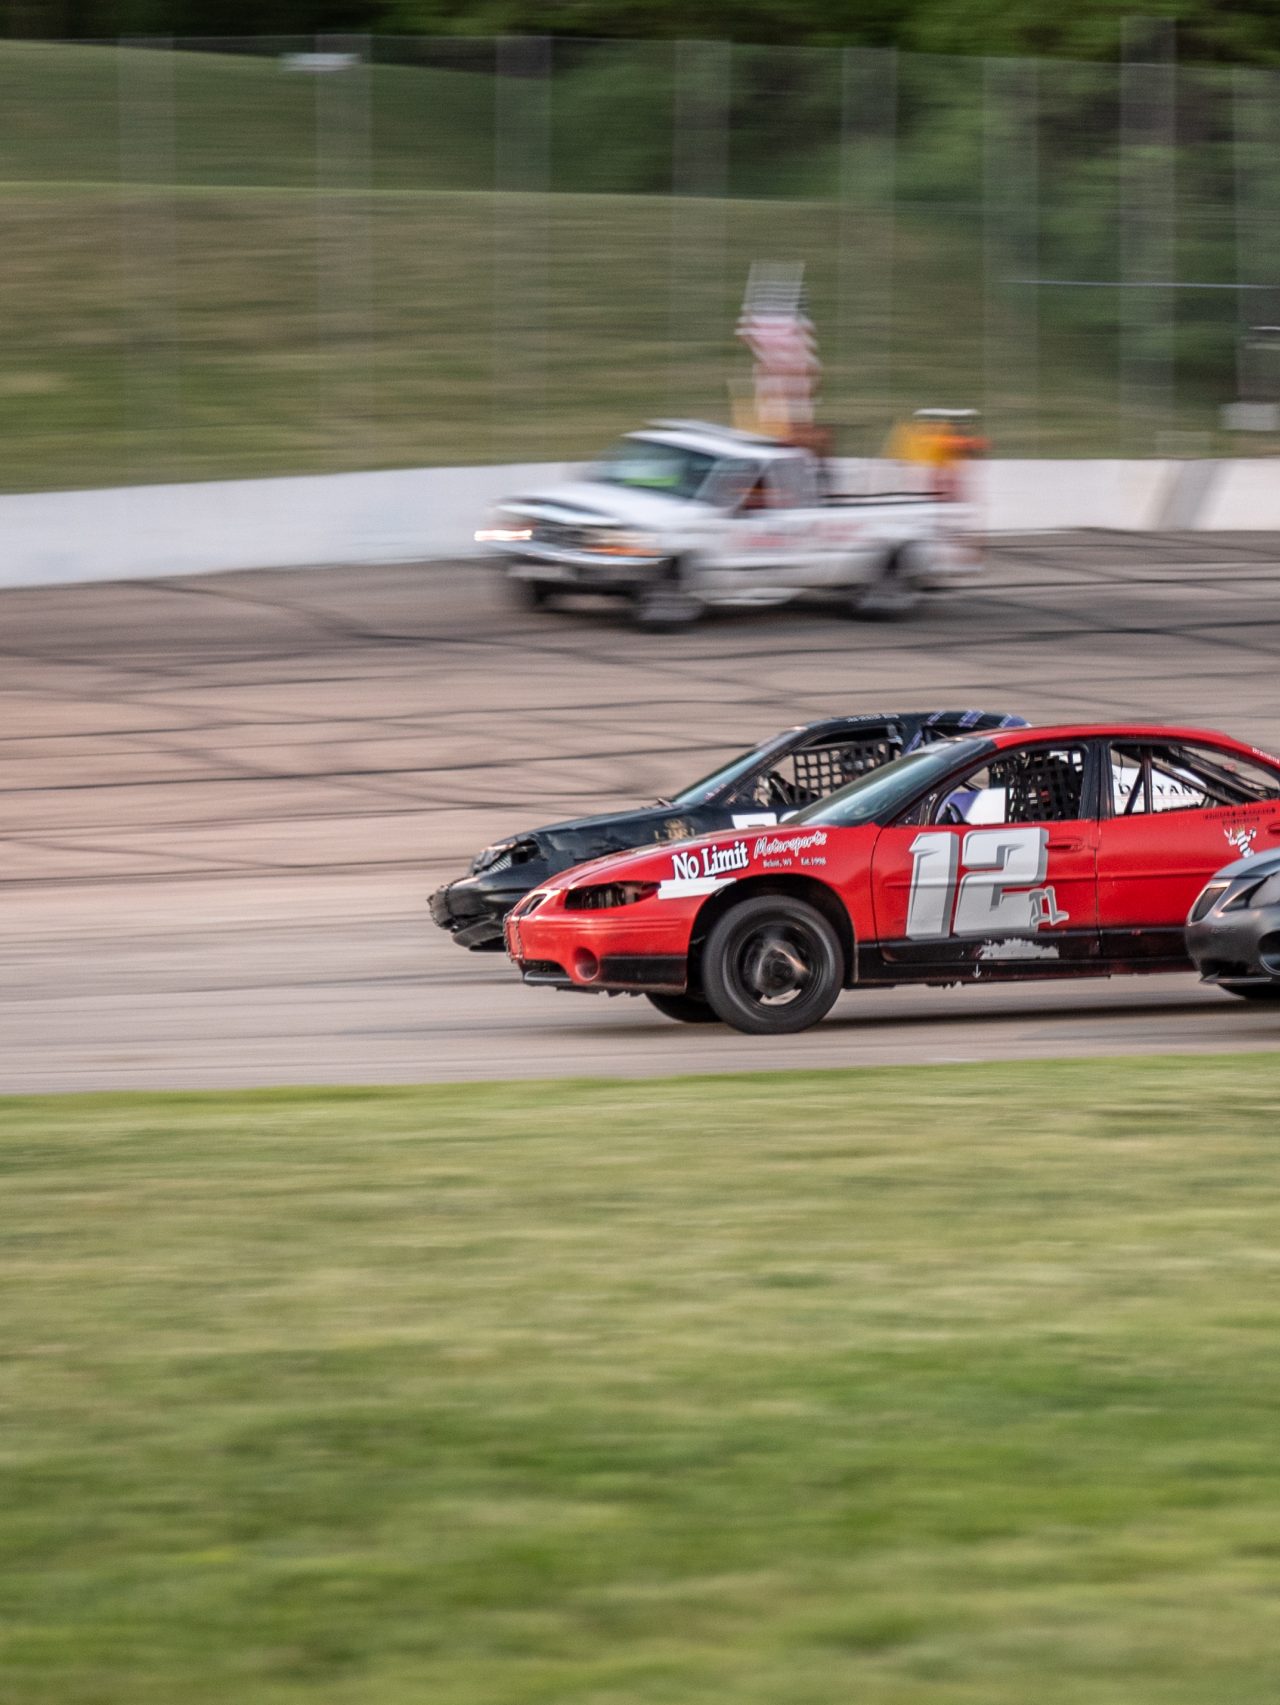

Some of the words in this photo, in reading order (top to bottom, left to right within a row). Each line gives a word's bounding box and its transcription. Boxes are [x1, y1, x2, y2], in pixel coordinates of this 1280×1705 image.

[671, 851, 700, 880] No
[701, 841, 749, 877] Limit
[754, 830, 827, 859] Motorsports
[906, 827, 1049, 941] 12
